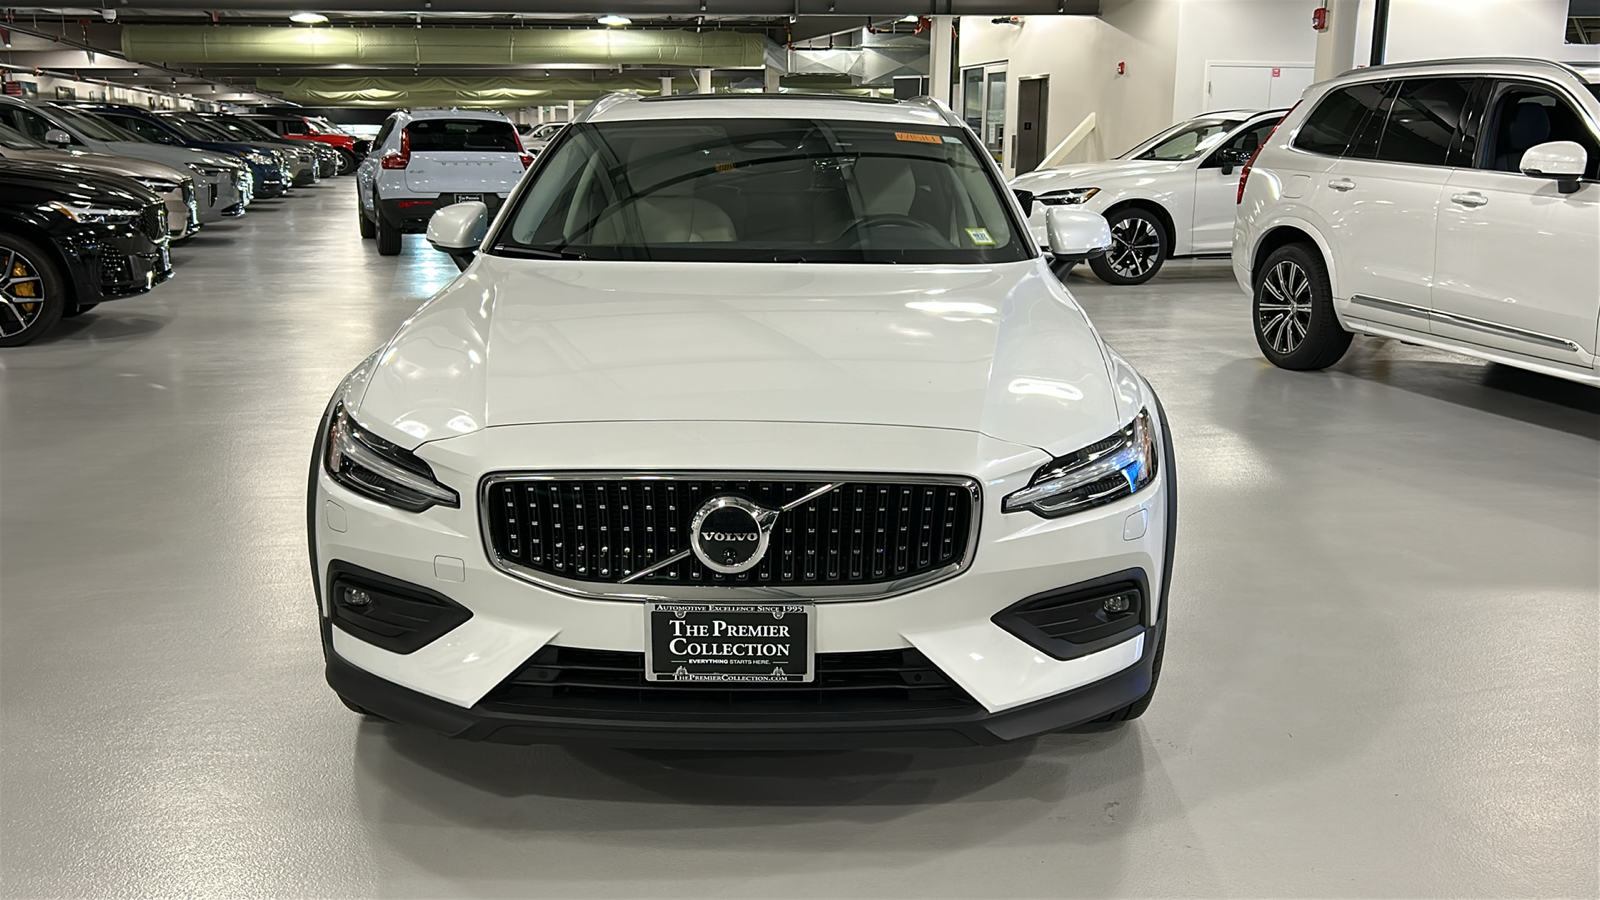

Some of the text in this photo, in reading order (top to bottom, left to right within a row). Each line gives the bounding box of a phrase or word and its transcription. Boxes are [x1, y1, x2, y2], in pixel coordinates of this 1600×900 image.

[701, 531, 758, 541] VOLVO
[708, 604, 756, 612] EXCELLENCE
[782, 605, 803, 613] 1995
[669, 620, 790, 637] THE PREMIER
[669, 638, 790, 656] COLLECTION
